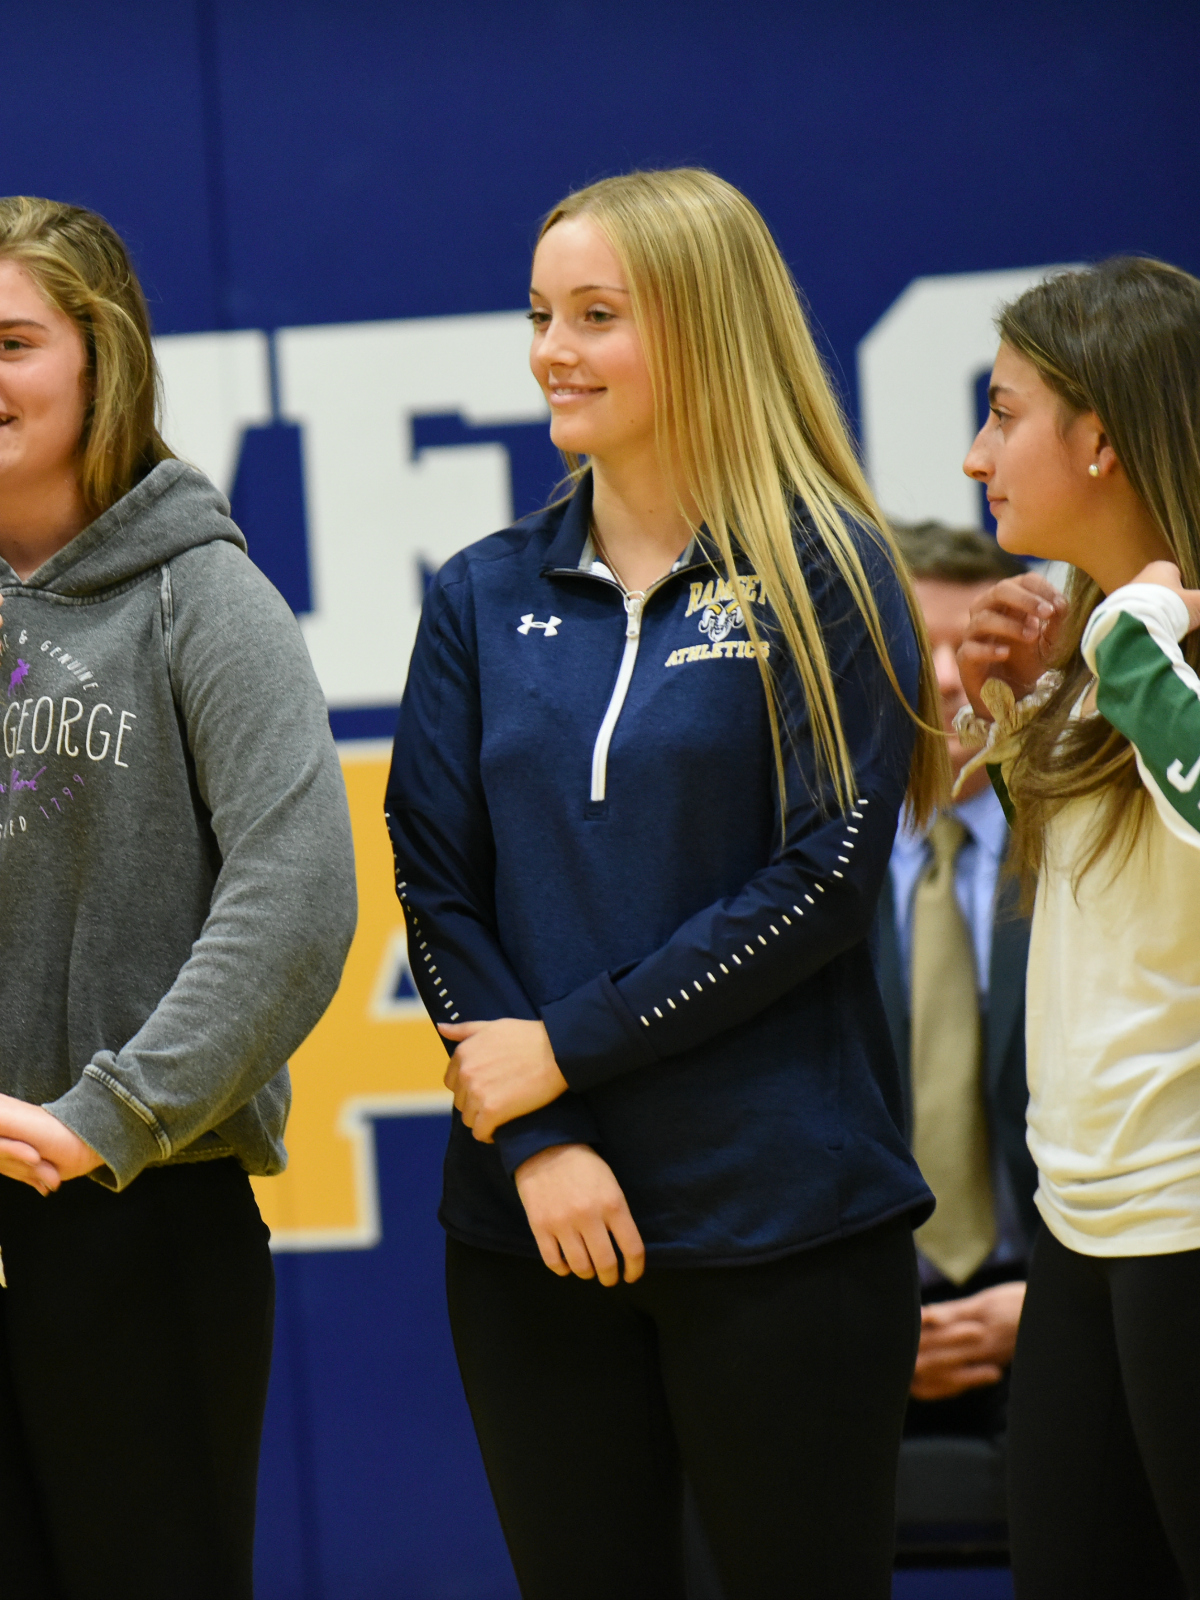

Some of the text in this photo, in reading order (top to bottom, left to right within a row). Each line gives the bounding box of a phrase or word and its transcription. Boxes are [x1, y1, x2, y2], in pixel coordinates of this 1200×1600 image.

[18, 628, 29, 645] &
[40, 639, 100, 692] GENUINE
[664, 640, 771, 668] ATHLETICS
[3, 695, 137, 768] GEORGE
[39, 773, 86, 820] 1799
